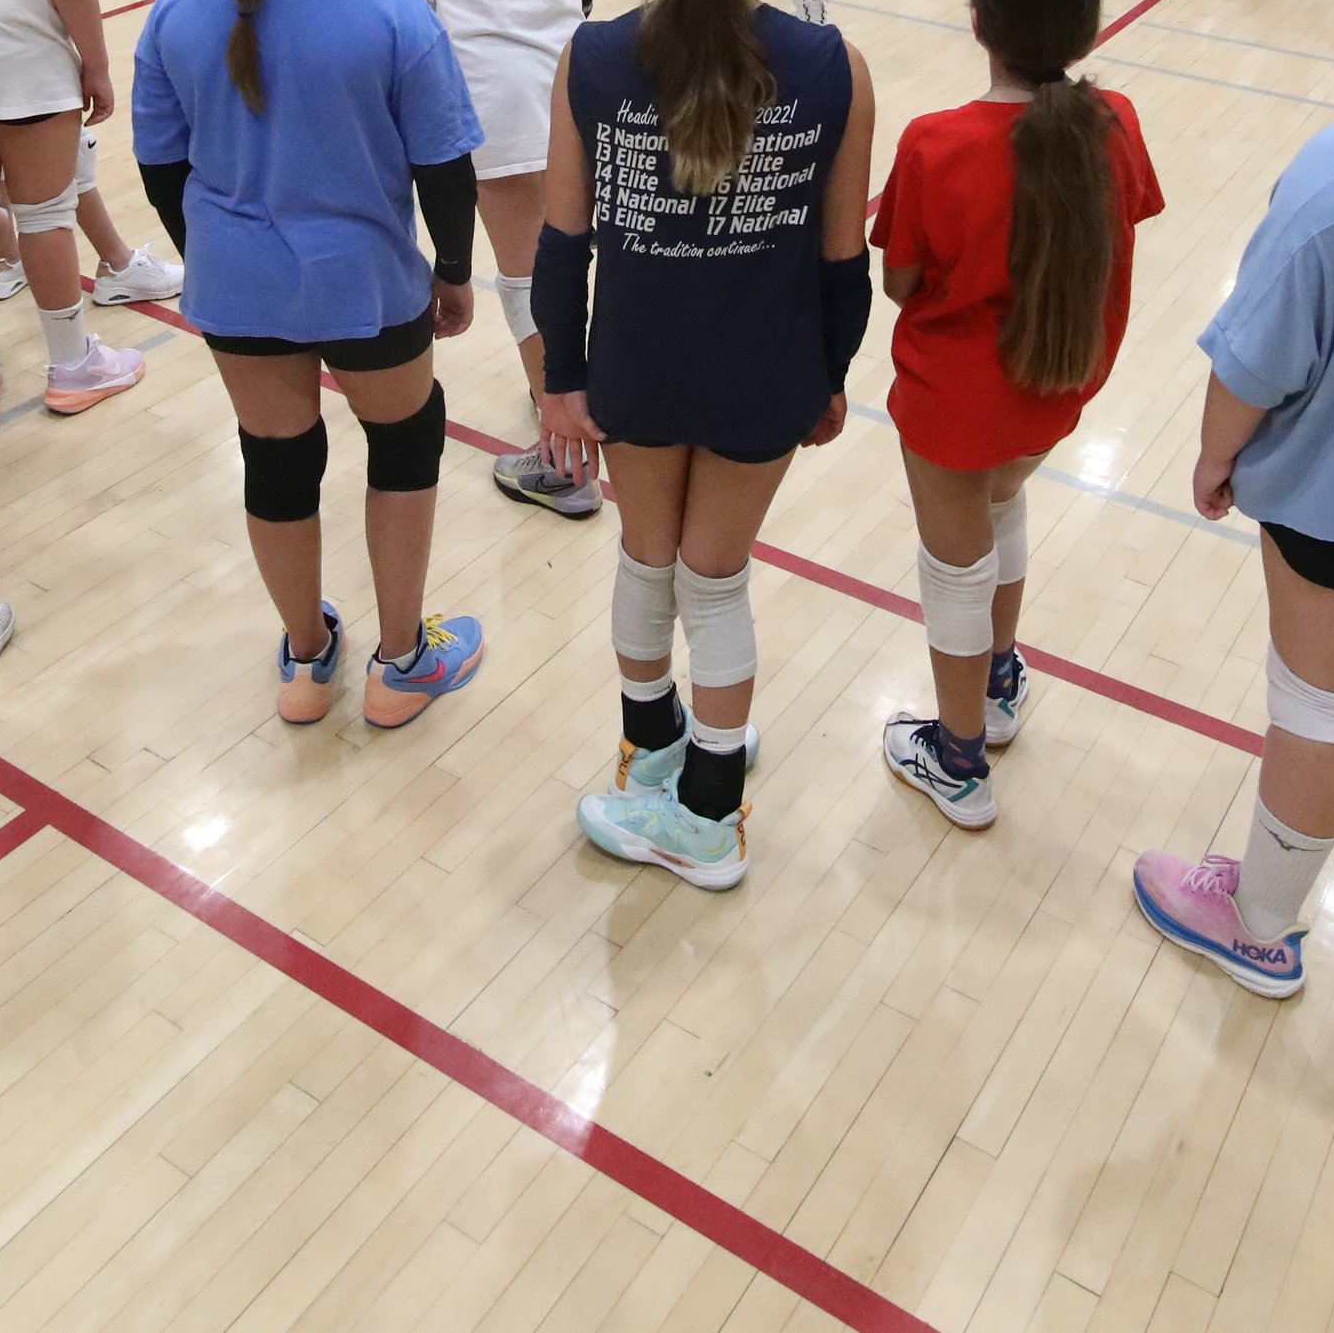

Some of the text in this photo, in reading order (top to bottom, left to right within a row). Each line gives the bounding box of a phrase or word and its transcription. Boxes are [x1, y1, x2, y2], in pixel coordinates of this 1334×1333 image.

[617, 98, 659, 127] Headin
[596, 122, 669, 152] 12 Nation
[595, 142, 657, 170] 13 Elite
[738, 155, 784, 174] Elite
[594, 161, 659, 192] 14 Elite
[736, 162, 816, 193] National
[594, 181, 698, 215] 14 National
[708, 195, 776, 215] 17 Elite
[596, 201, 656, 232] 15 Elite
[706, 205, 808, 236] 17 National
[622, 232, 647, 254] The
[650, 240, 704, 259] tradition
[1232, 938, 1287, 965] HOKA
